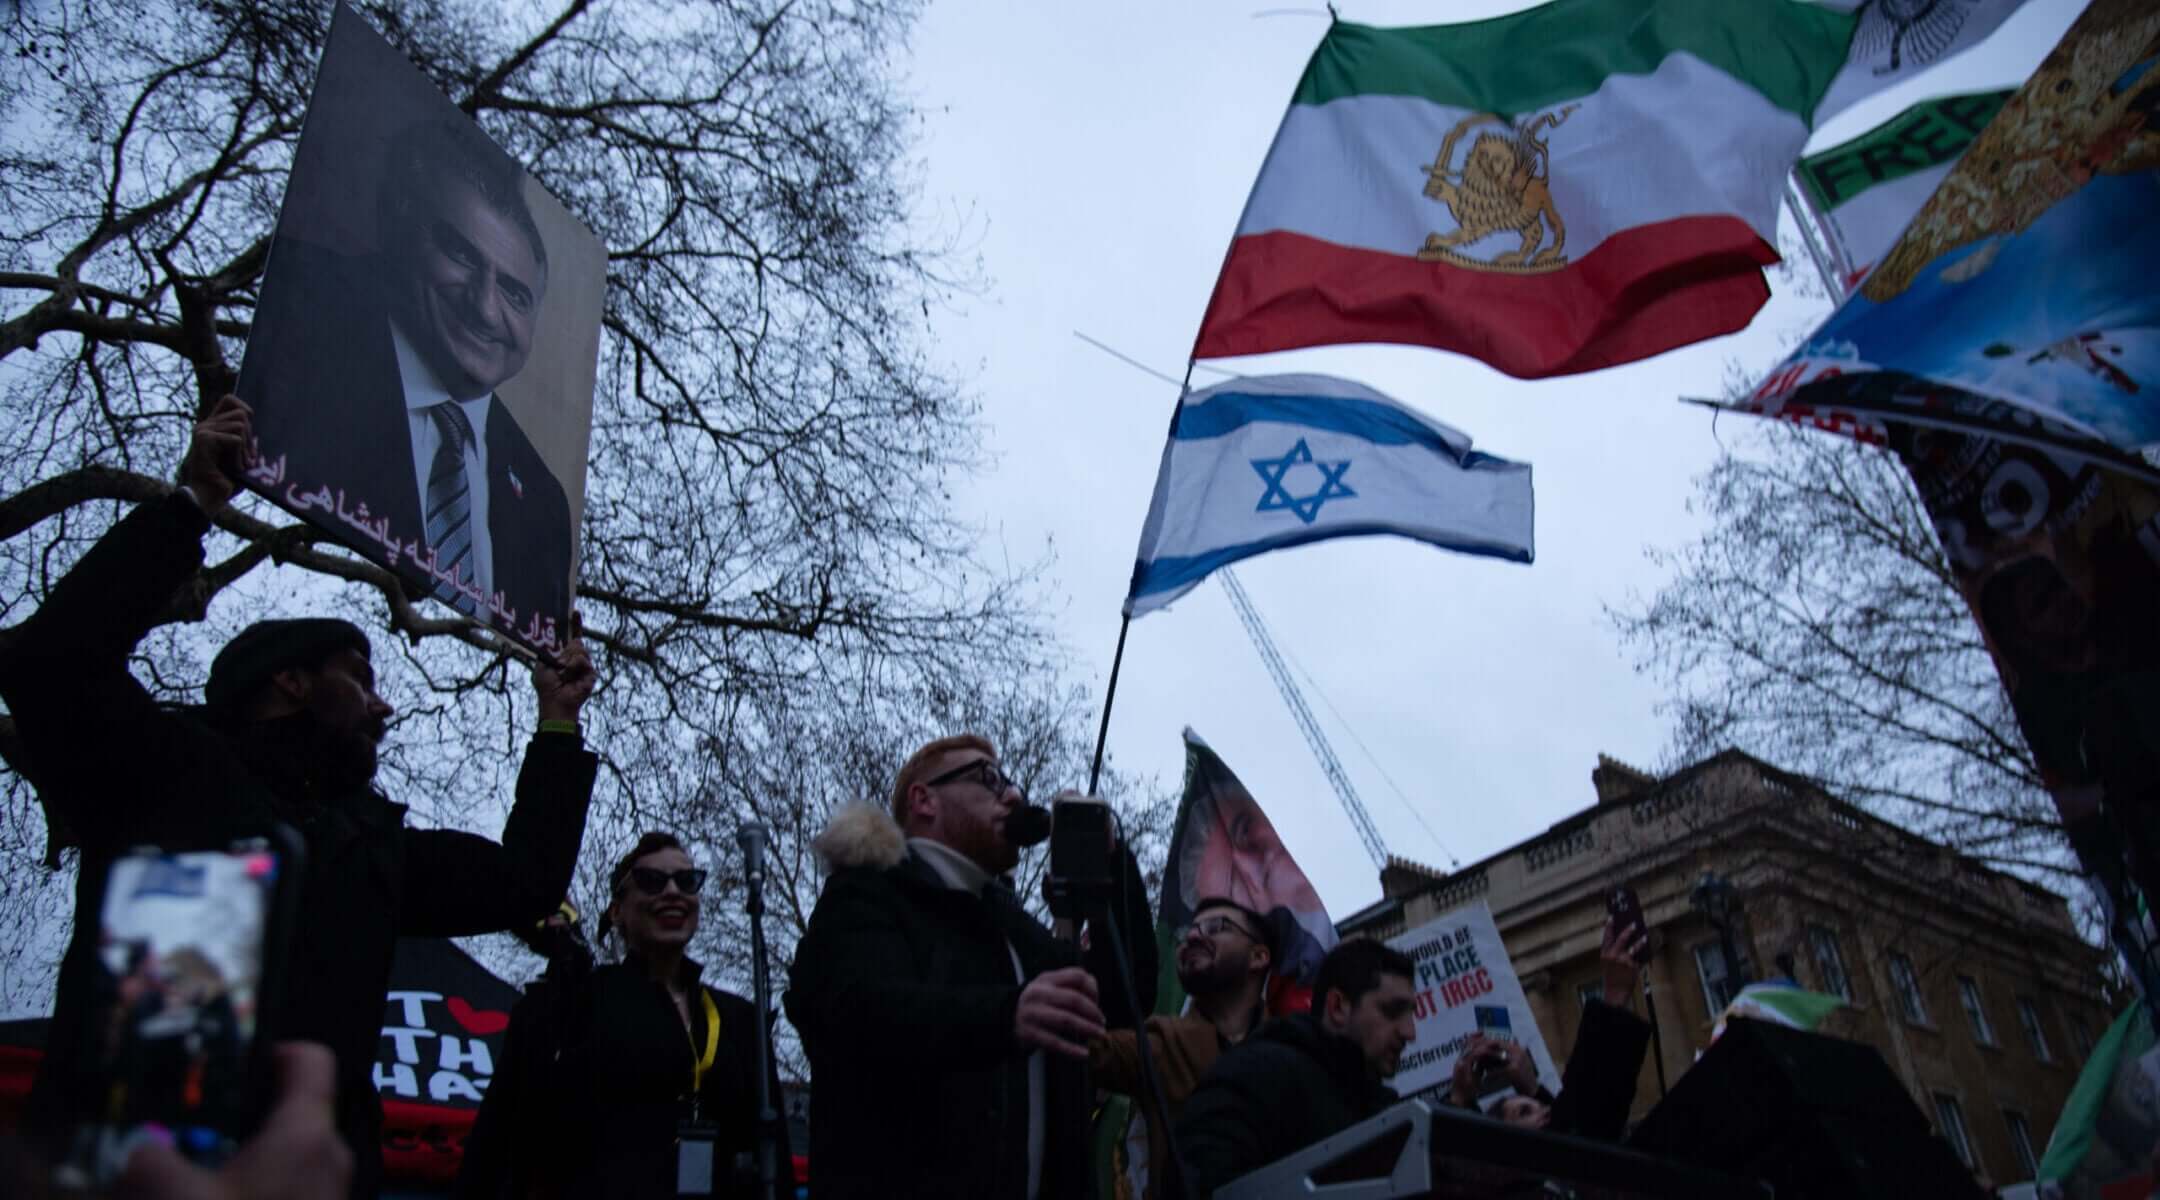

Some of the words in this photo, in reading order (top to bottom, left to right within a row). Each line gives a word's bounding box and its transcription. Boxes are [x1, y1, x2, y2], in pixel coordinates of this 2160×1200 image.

[517, 611, 565, 659] رقرار
[1418, 945, 1482, 987] PLACE
[1440, 966, 1494, 1009] IRGC
